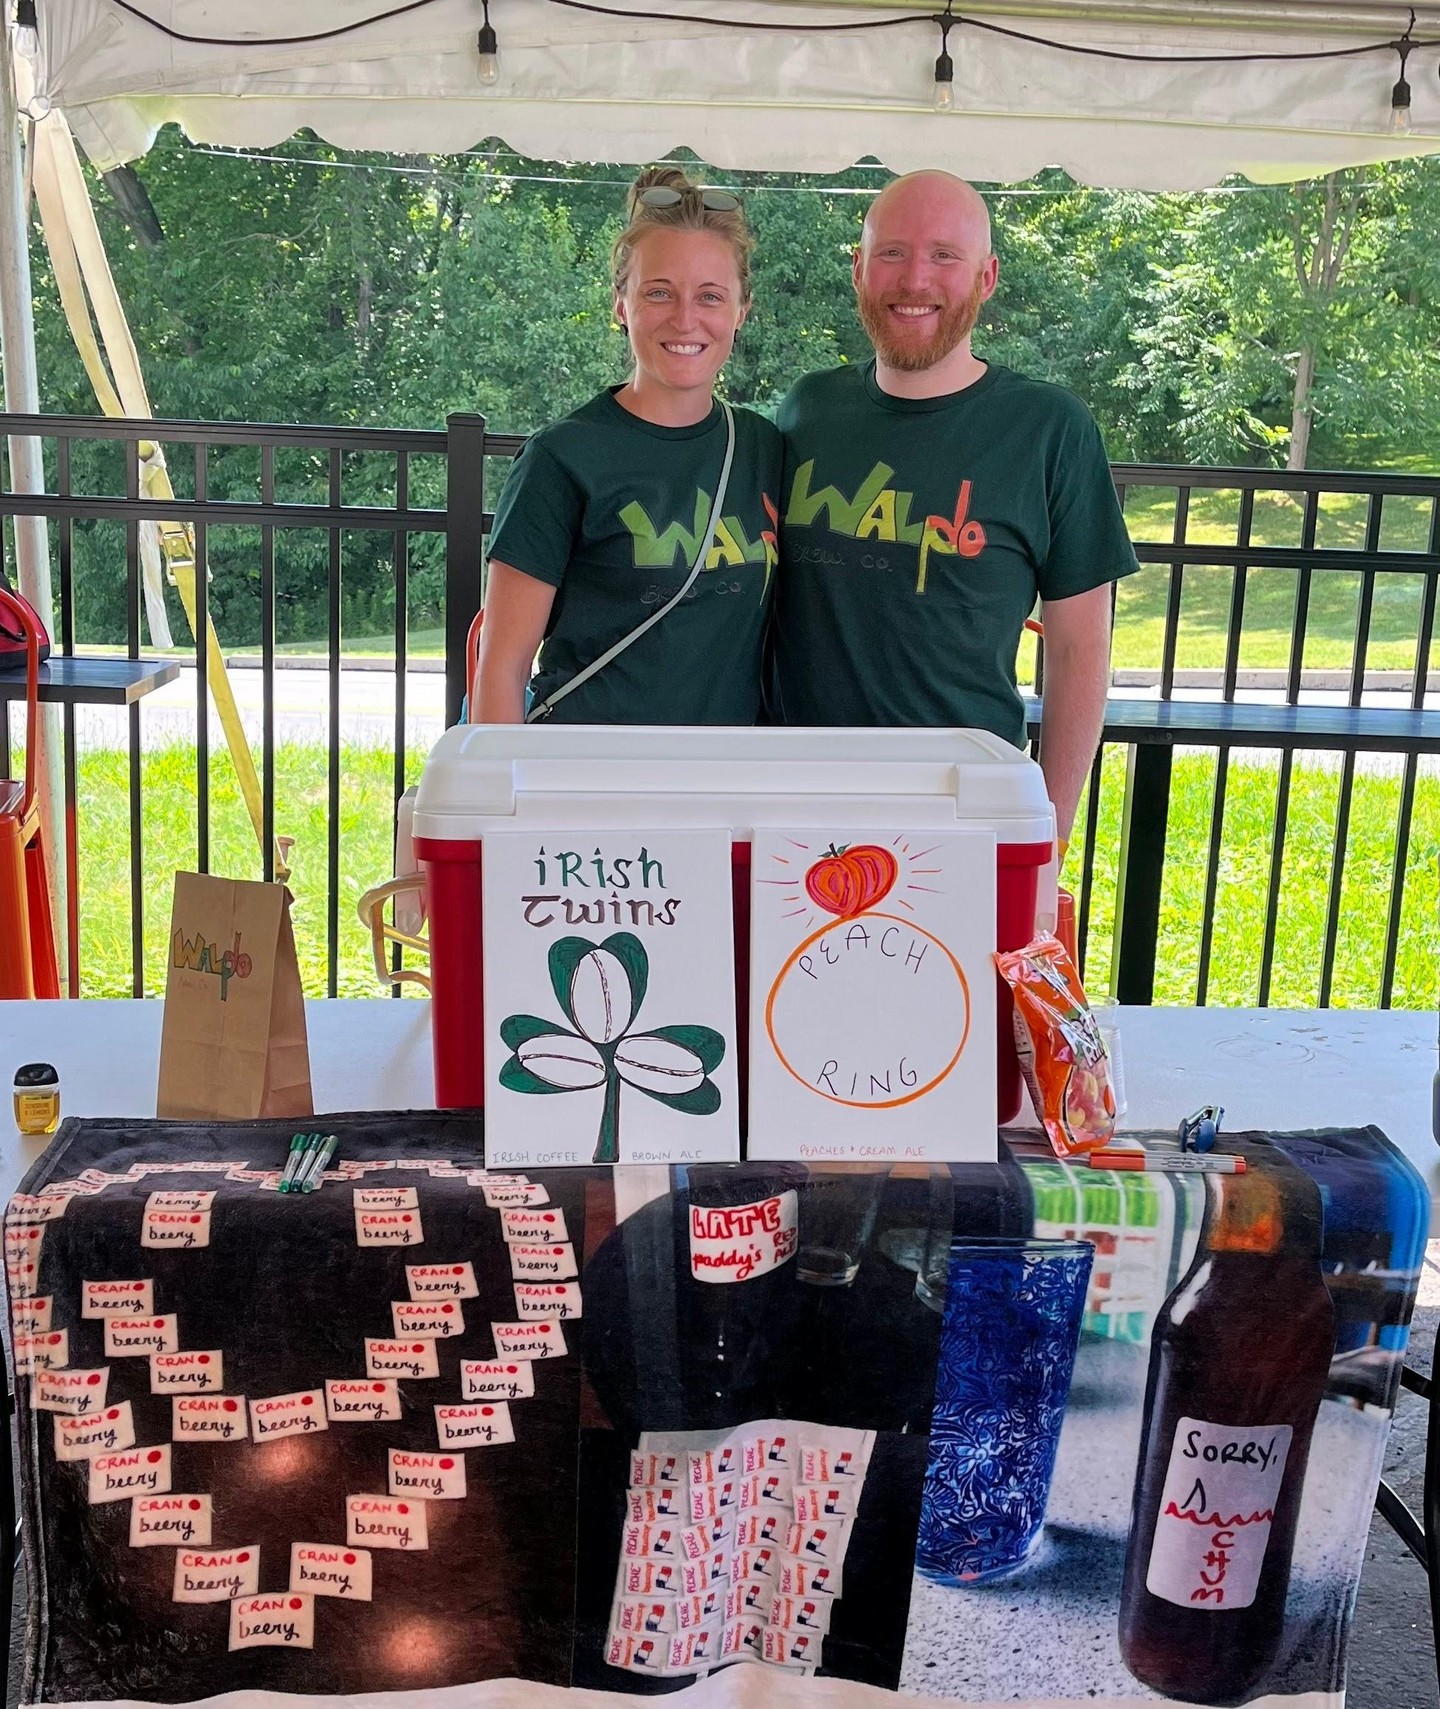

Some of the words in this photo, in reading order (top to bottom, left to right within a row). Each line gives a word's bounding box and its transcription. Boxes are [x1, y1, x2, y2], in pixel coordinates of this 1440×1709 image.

[798, 923, 929, 980] PEACH
[815, 1056, 919, 1098] RING
[799, 1143, 845, 1157] PEACHES
[859, 1145, 897, 1157] CREAM
[904, 1146, 926, 1157] ALE
[492, 1151, 530, 1164] IRISH
[536, 1151, 579, 1163] COFFEE
[631, 1151, 672, 1161] BROWN
[680, 1149, 703, 1160] ALE
[148, 1213, 188, 1223] CRAN
[361, 1215, 398, 1225] CRAN
[503, 1212, 541, 1223] CRAN
[512, 1246, 550, 1256] CRAN
[410, 1267, 450, 1278] CRAN
[88, 1283, 131, 1294] CRAN
[516, 1285, 552, 1296] CRAN
[396, 1305, 437, 1315] CRAN
[110, 1320, 151, 1330] CRAN
[496, 1325, 537, 1337] CRAN
[369, 1343, 408, 1353] CRAN
[155, 1355, 195, 1366] CRAN
[465, 1364, 504, 1375] CRAN
[37, 1372, 82, 1387] CRAN
[330, 1383, 369, 1394] CRAN
[178, 1400, 219, 1412] CRAN
[255, 1399, 296, 1414] CRAN
[439, 1408, 478, 1419] CRAN
[60, 1415, 103, 1429] CRAN
[95, 1454, 141, 1471] CRAN
[392, 1454, 435, 1468] CRAN
[138, 1498, 183, 1512] CRAN
[350, 1501, 392, 1514] CRAN
[181, 1554, 233, 1567] CRAN
[297, 1549, 339, 1562] CRAN
[238, 1599, 285, 1615] CRAN
